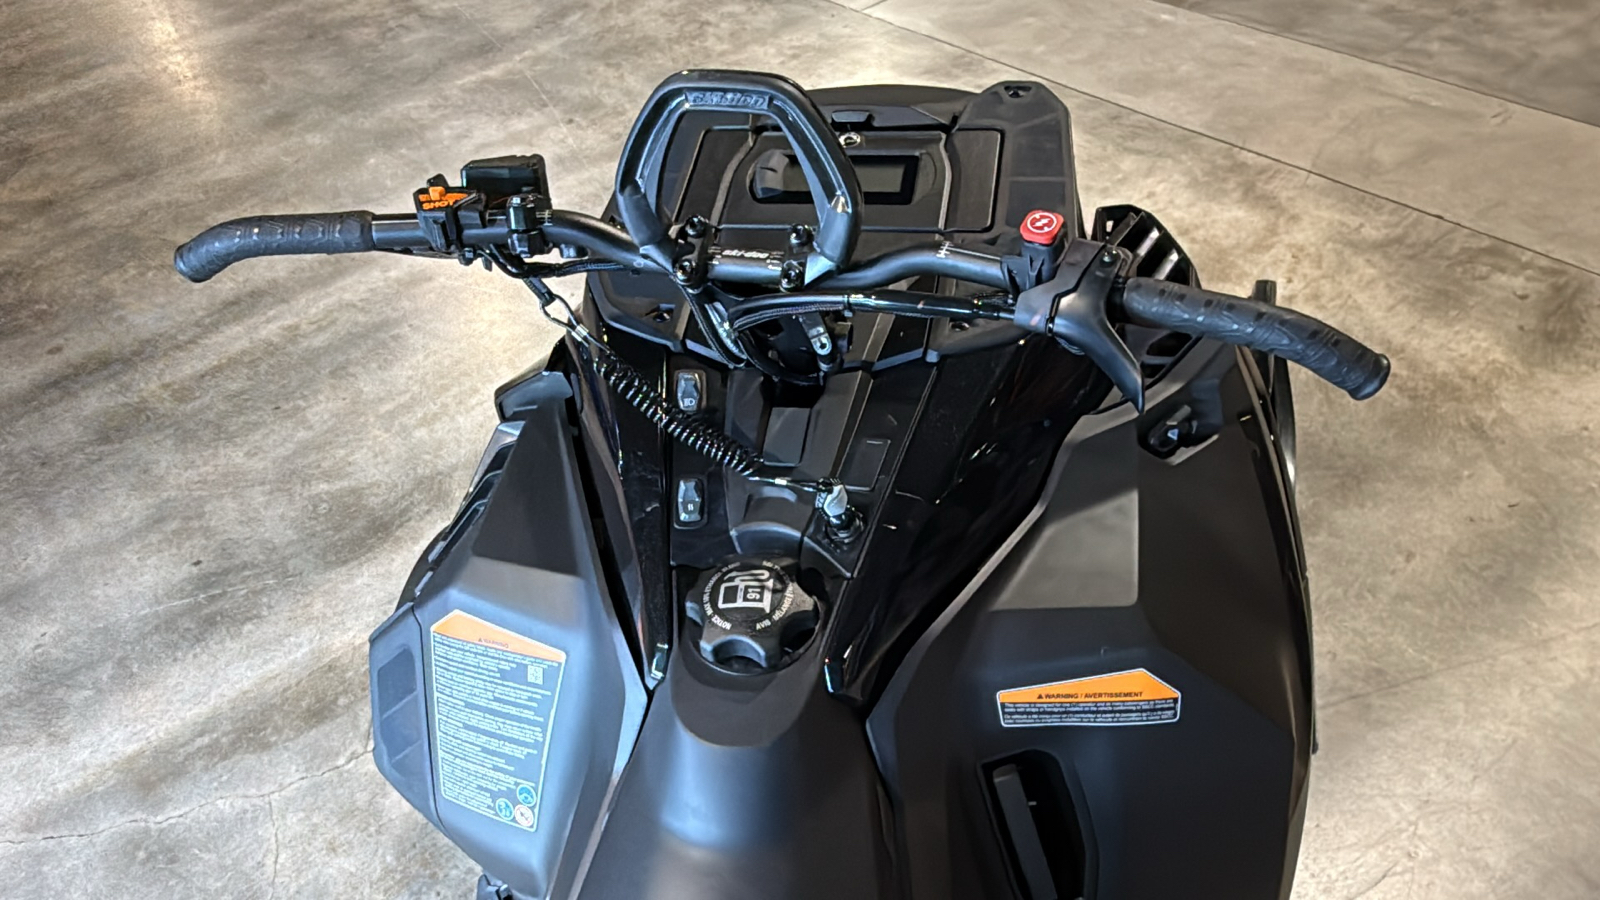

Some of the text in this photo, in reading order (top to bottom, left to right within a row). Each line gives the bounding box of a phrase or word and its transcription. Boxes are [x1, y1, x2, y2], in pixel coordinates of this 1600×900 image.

[422, 199, 456, 210] SHOT
[722, 248, 770, 259] ski-doo
[746, 587, 761, 600] 91
[711, 614, 732, 630] NOTICE
[756, 619, 771, 630] AVIS
[1084, 691, 1144, 699] AVERTISSEMENT
